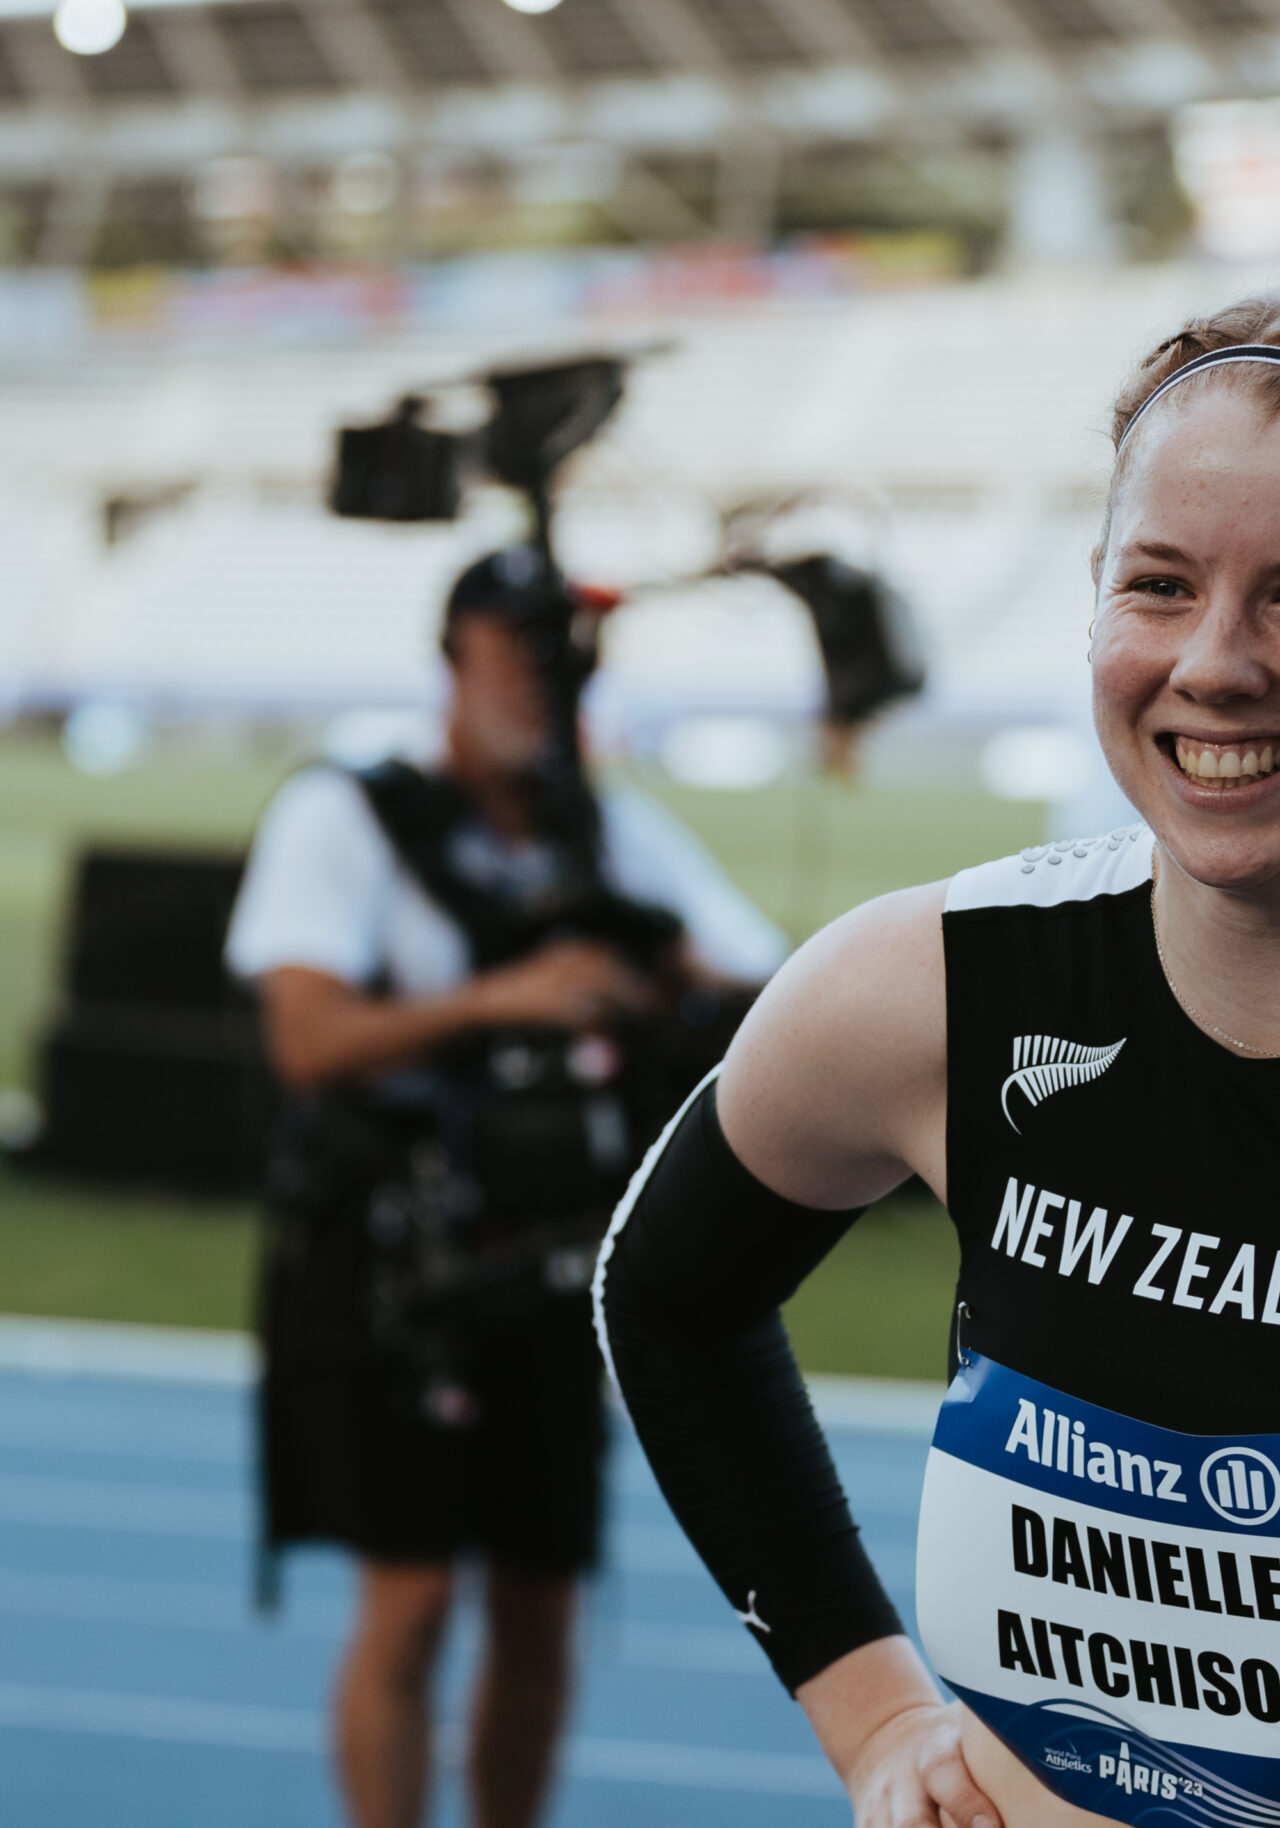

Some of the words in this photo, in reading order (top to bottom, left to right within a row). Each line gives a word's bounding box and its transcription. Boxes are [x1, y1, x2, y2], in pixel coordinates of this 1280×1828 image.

[991, 1176, 1134, 1286] NEW
[1005, 1397, 1187, 1503] Allianz
[1045, 1753, 1093, 1774] Athletics
